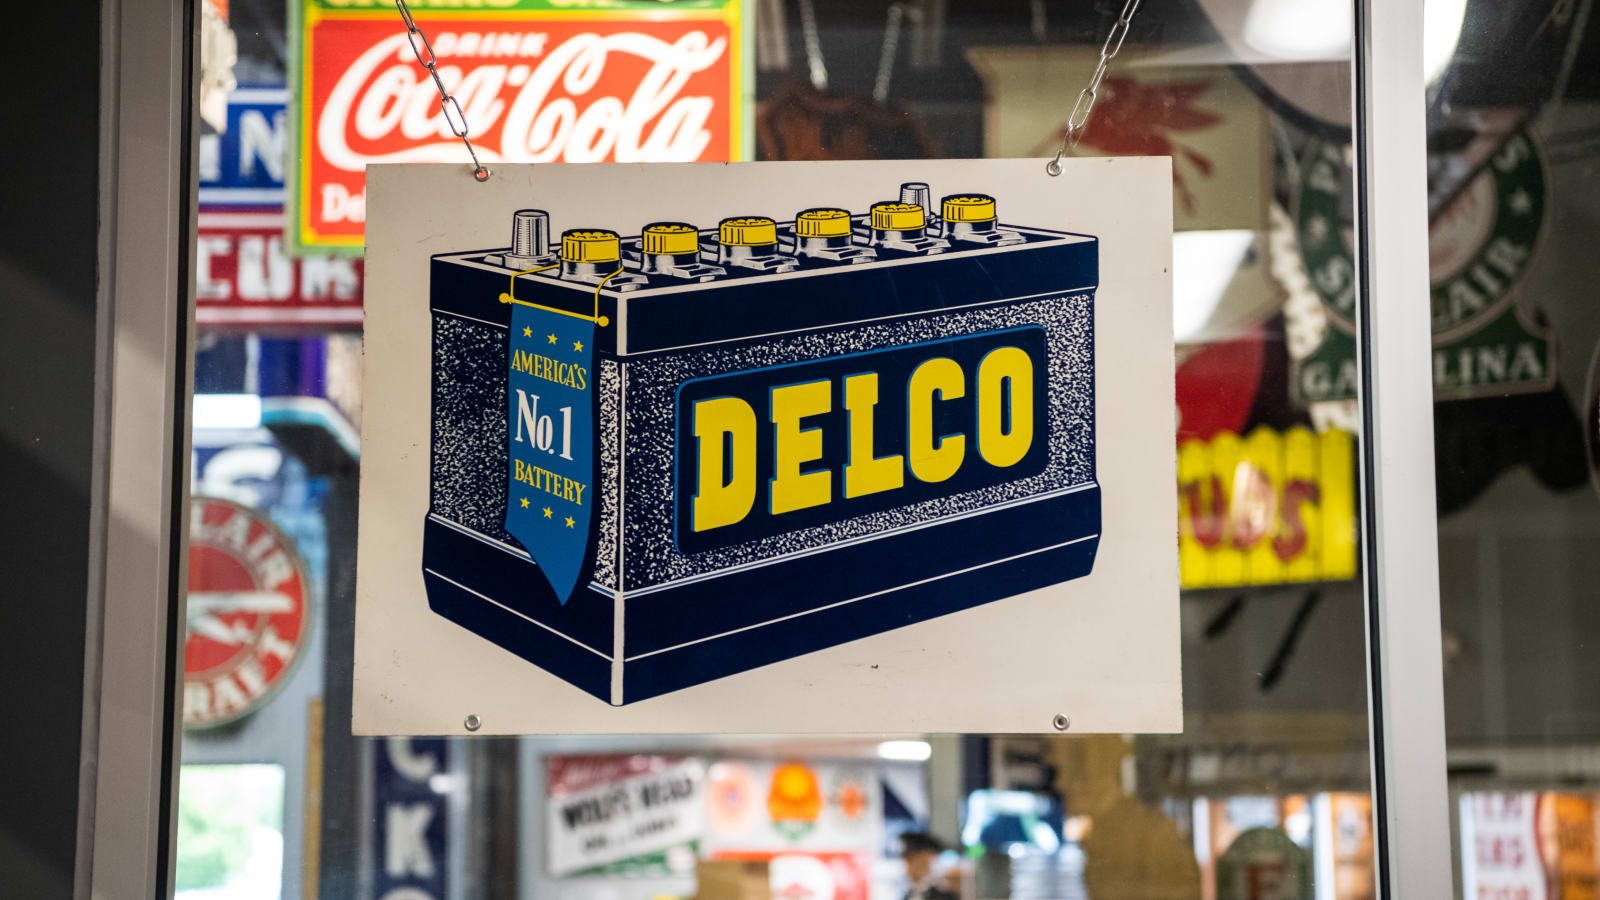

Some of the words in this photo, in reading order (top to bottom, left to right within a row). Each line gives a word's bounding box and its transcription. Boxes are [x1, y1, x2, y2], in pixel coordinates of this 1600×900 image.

[434, 32, 548, 58] DRINK
[318, 30, 728, 172] Coca-Cola
[511, 349, 587, 390] AMERICA'S
[692, 346, 1034, 532] DELCO
[514, 459, 587, 505] BATTERY
